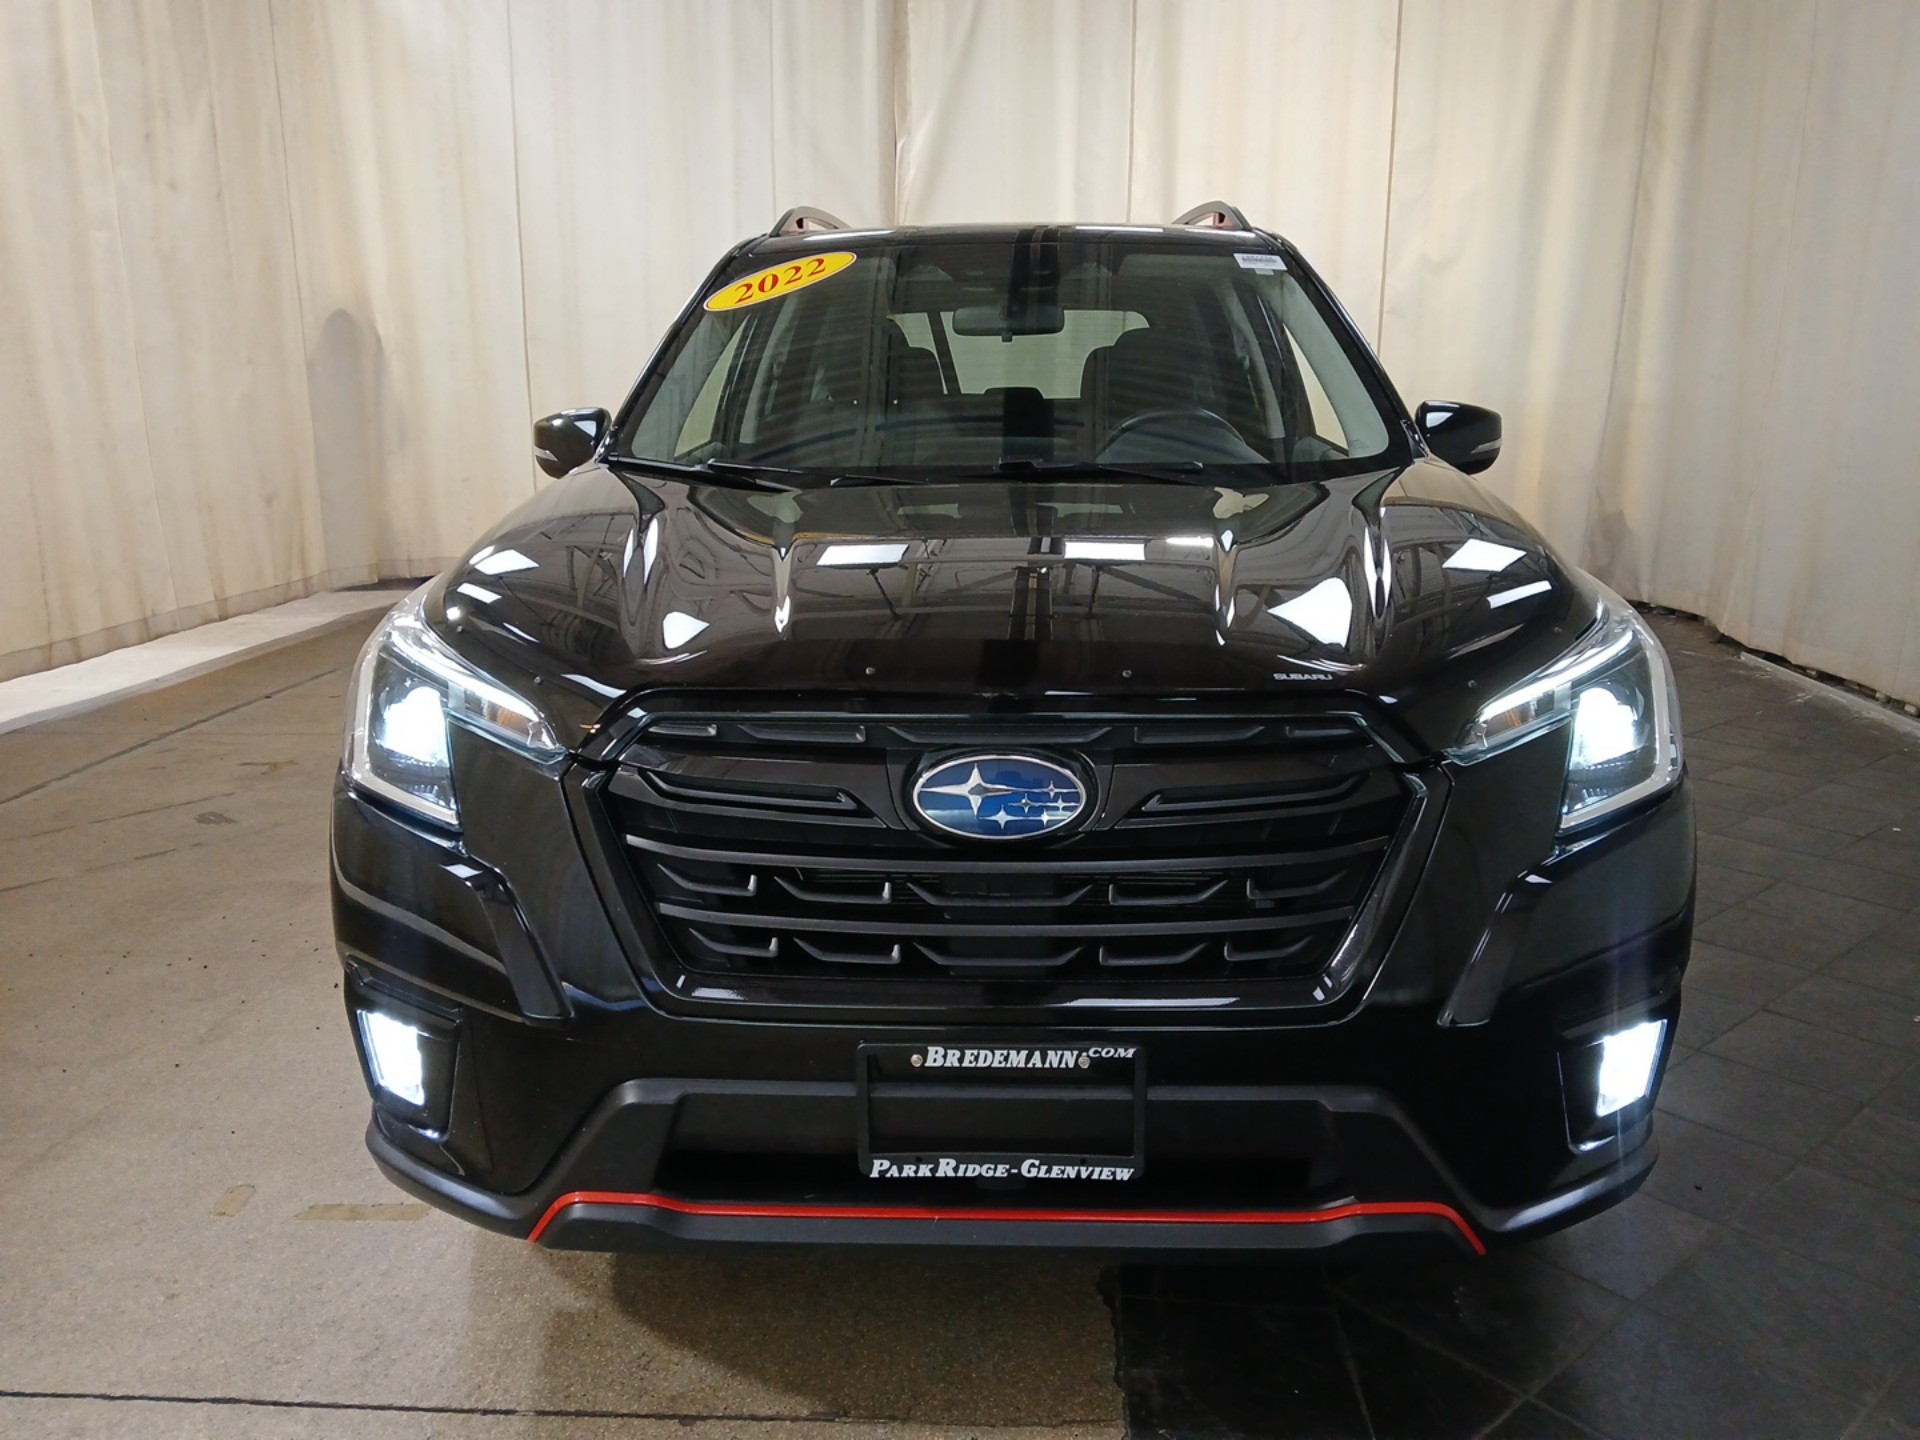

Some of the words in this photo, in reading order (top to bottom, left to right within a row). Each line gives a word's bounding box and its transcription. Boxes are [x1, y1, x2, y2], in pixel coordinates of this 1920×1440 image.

[734, 257, 826, 305] 2022
[1272, 672, 1333, 681] SUBARU
[869, 1158, 934, 1178] PARK
